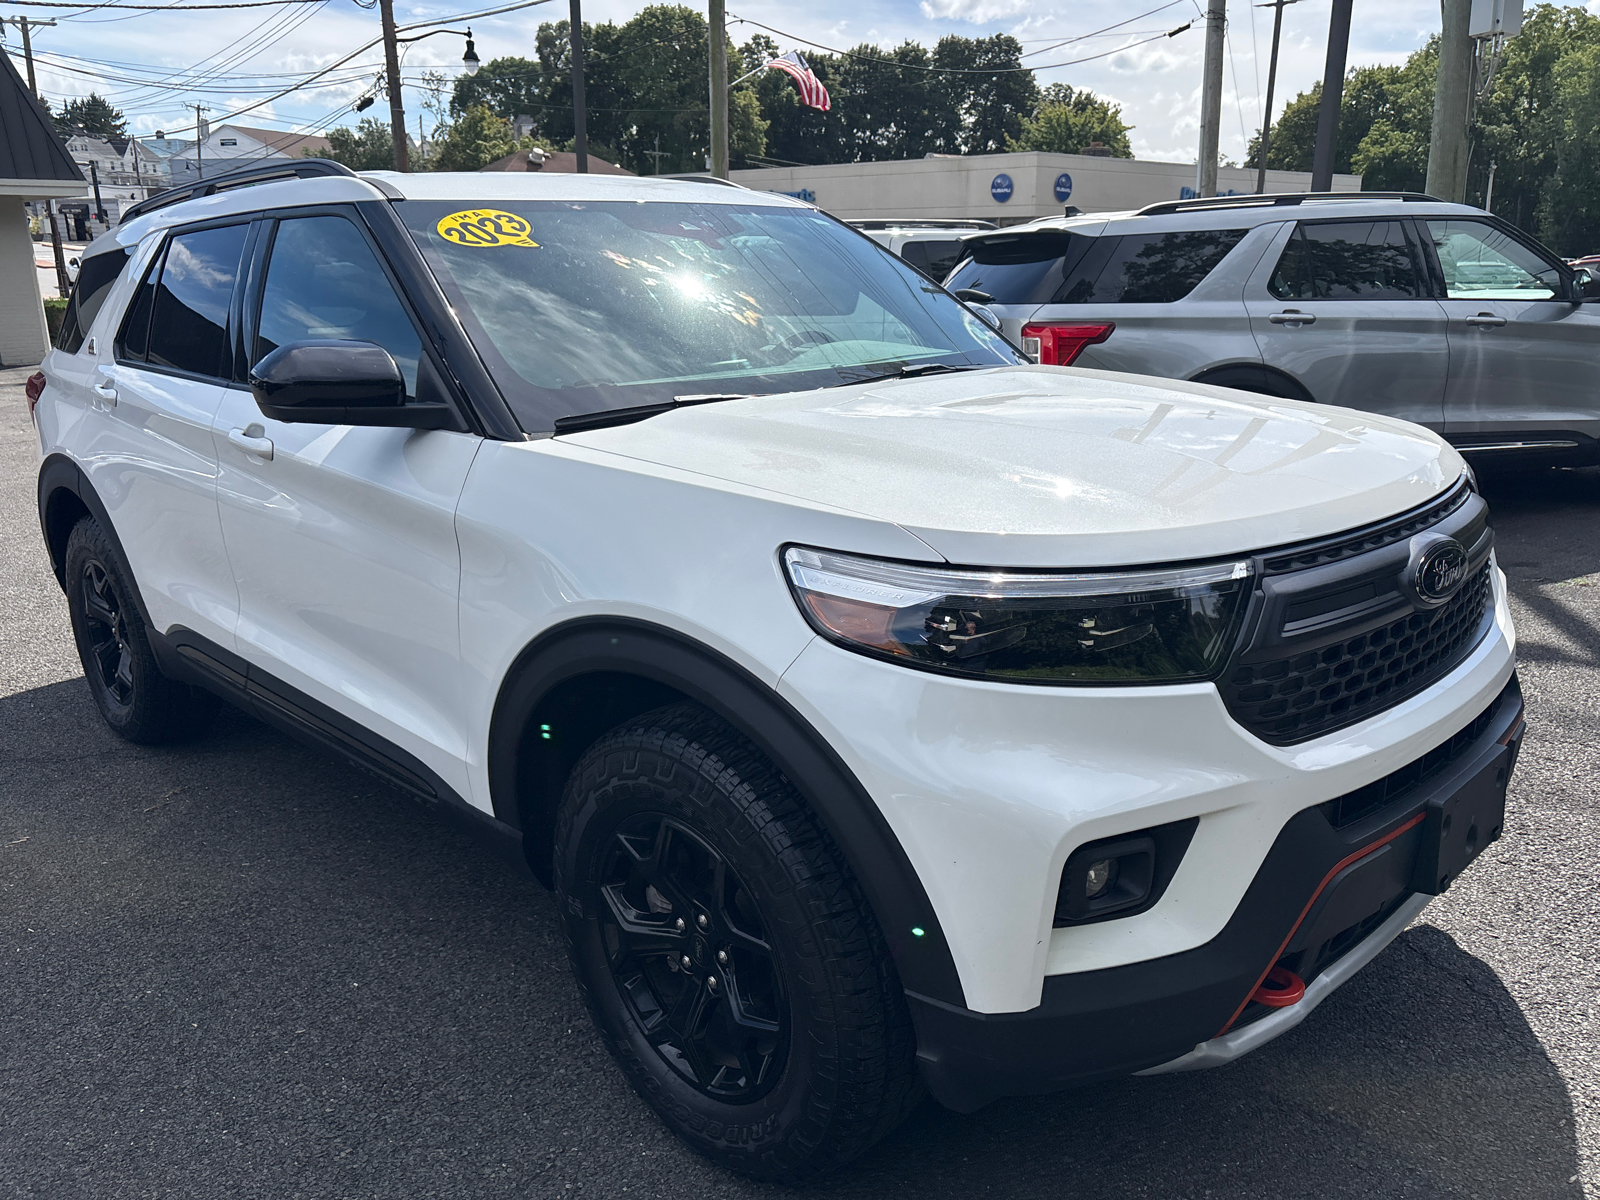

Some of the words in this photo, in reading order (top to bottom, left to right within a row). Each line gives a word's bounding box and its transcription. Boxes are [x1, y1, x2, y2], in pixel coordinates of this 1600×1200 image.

[444, 214, 527, 245] 2023
[451, 213, 472, 223] I'M
[1432, 553, 1462, 592] Ford
[810, 576, 905, 600] EXPLORER
